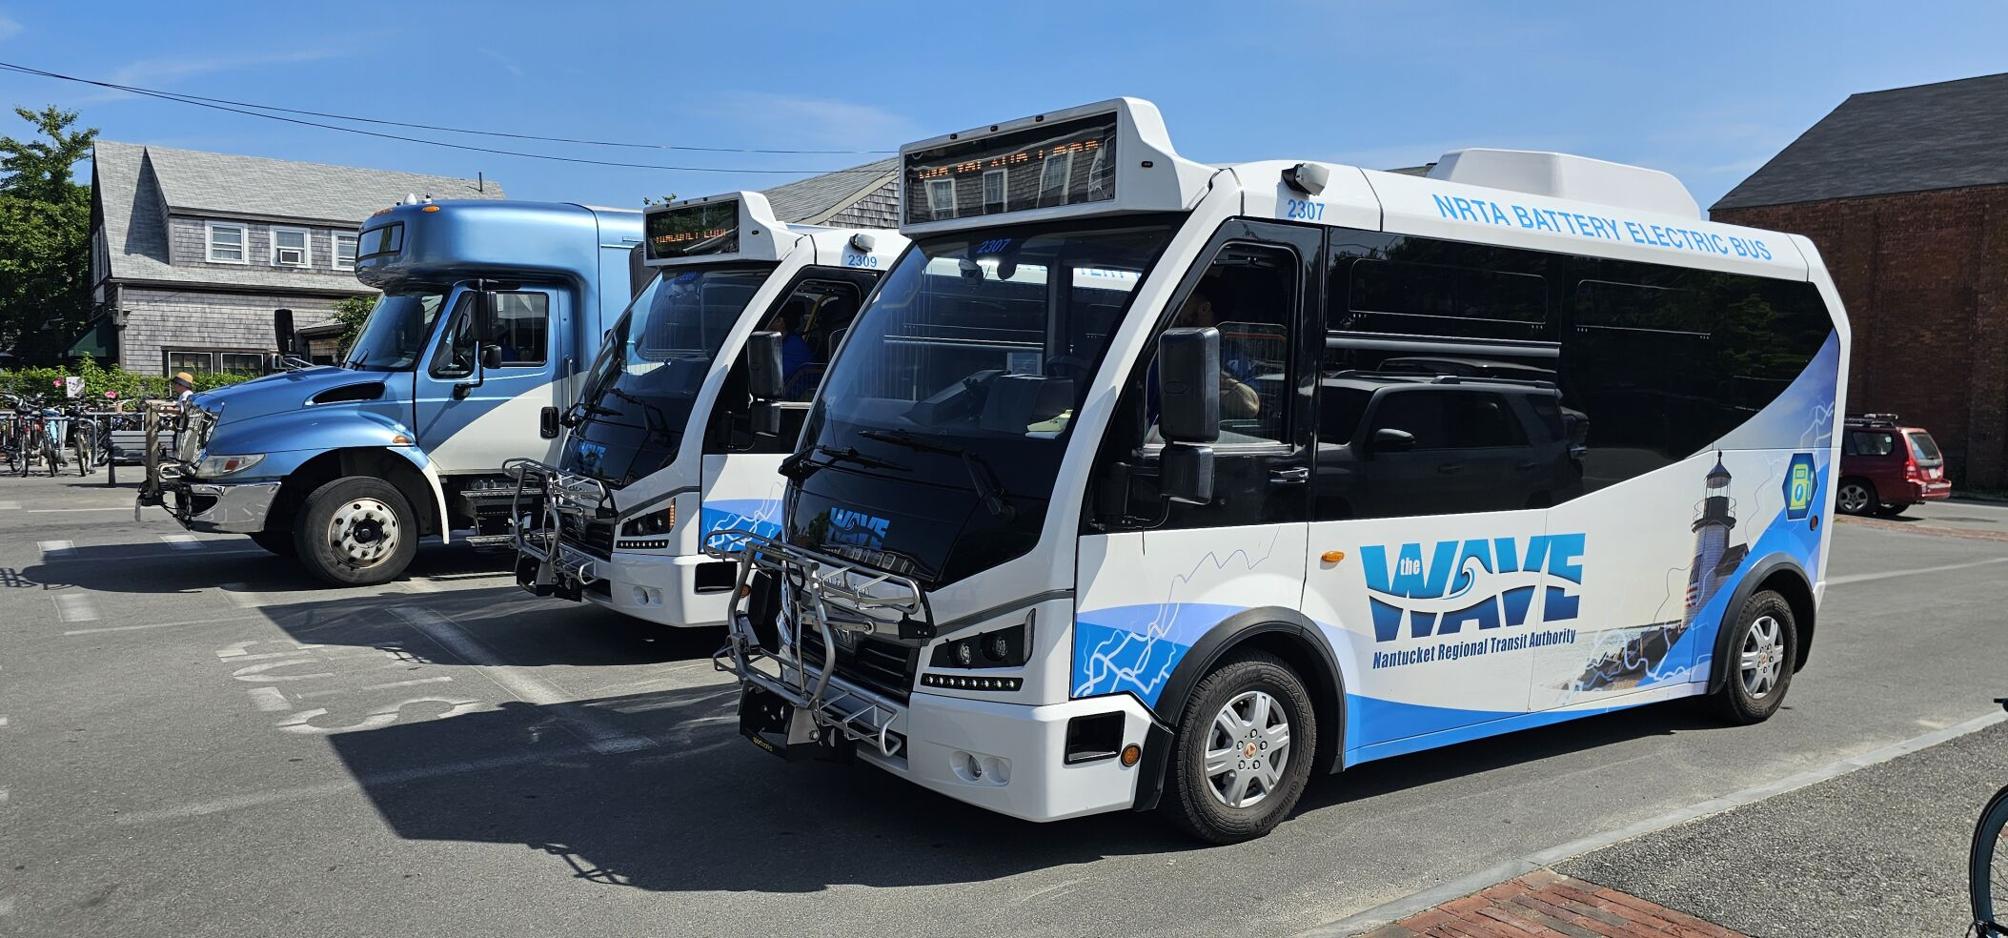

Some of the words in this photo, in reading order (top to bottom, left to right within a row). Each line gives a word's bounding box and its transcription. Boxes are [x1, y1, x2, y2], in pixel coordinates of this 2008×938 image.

[1287, 199, 1325, 220] 2307
[1432, 194, 1511, 226] NRTA
[1511, 205, 1620, 240] BATTERY
[1624, 221, 1728, 255] ELECTRIC
[1728, 236, 1772, 260] BUS
[848, 254, 877, 268] 2309
[976, 238, 1011, 254] 2307
[829, 506, 891, 549] WAVE
[1400, 557, 1421, 576] the
[1359, 533, 1586, 643] WAVE
[1372, 647, 1436, 669] Nantucket
[1437, 641, 1488, 661] Regional
[1490, 633, 1528, 653] Transit
[1528, 628, 1577, 648] Authority
